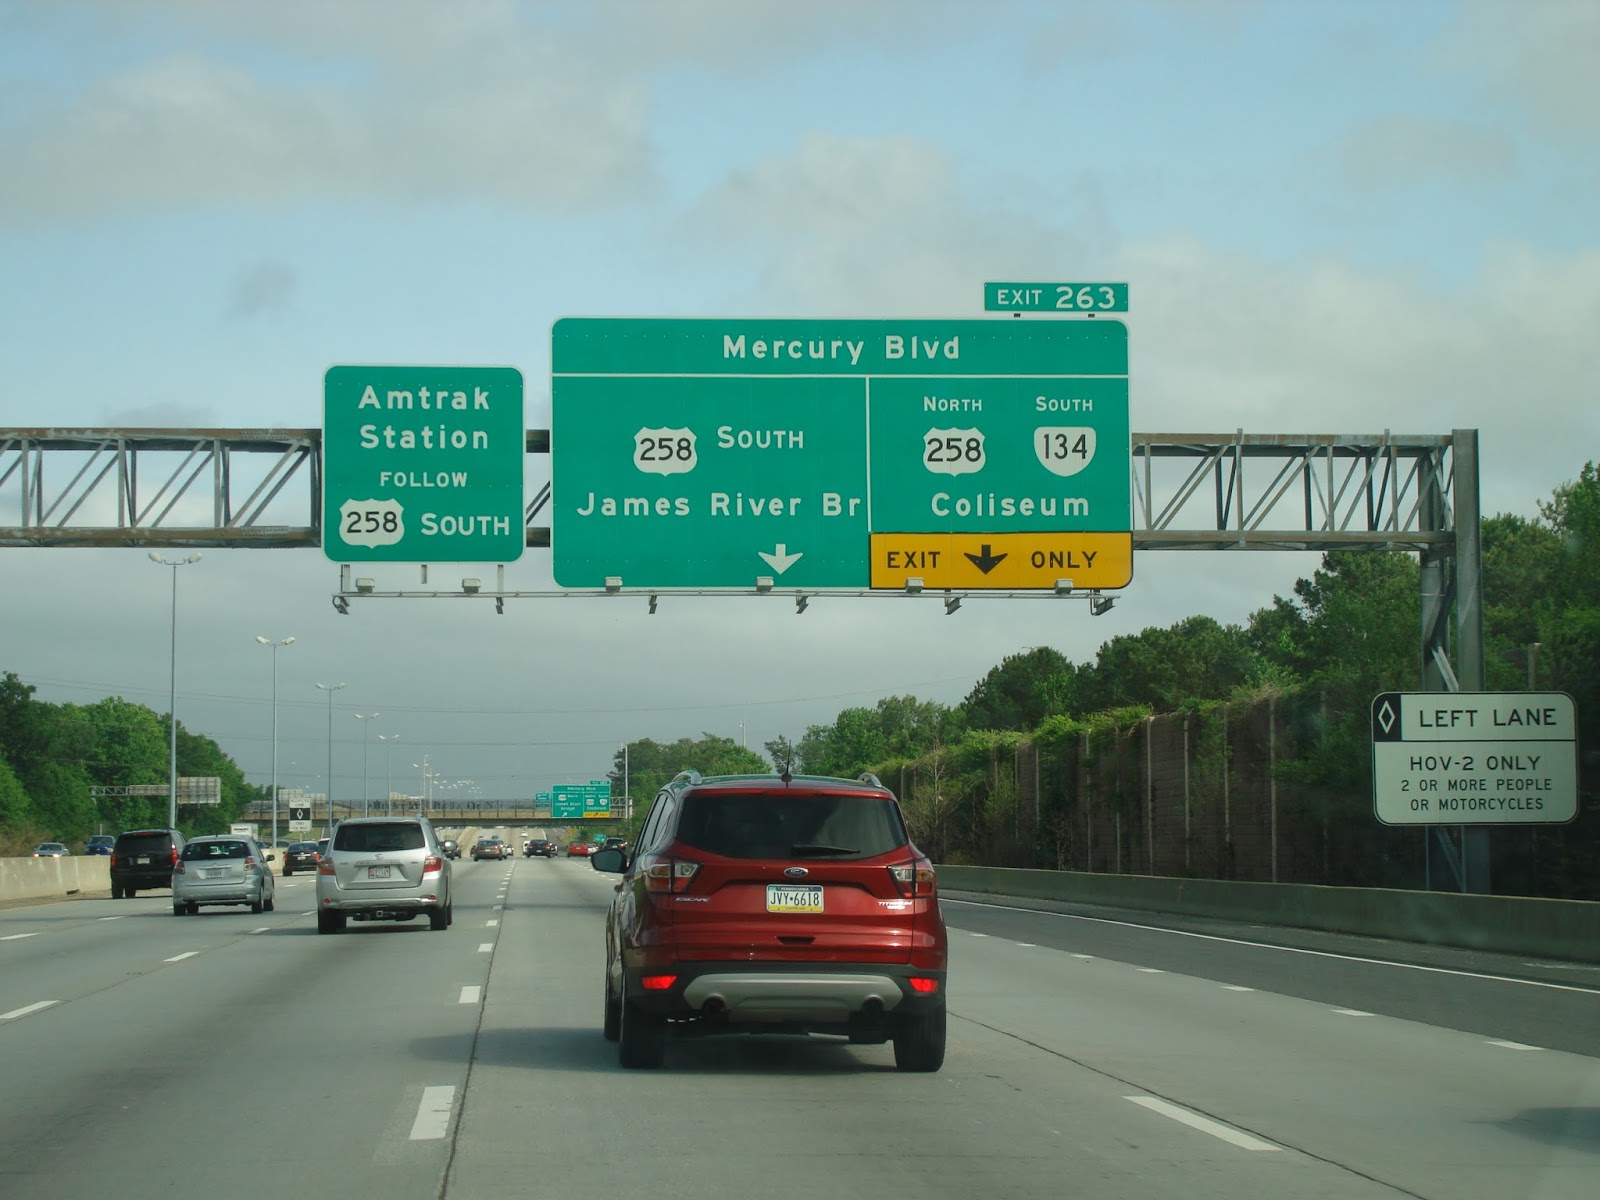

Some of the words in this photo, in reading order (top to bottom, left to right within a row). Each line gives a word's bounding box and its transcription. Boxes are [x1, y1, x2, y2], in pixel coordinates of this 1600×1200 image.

[997, 289, 1043, 305] EXIT
[1055, 286, 1116, 309] 263
[723, 334, 865, 366] Mercury
[885, 335, 960, 359] Blvd
[357, 385, 490, 410] Amtrak
[923, 396, 983, 412] NORTH
[1035, 396, 1093, 412] SOUTH
[359, 424, 489, 449] Station
[639, 437, 692, 461] 258
[716, 425, 804, 449] SOUTH
[1043, 433, 1088, 460] 134
[927, 437, 982, 463] 258
[379, 472, 468, 488] FOLLOW
[576, 492, 690, 517] James
[710, 492, 802, 517] River
[822, 492, 861, 517] Br
[931, 492, 1089, 517] Coliseum
[346, 510, 398, 534] 258
[420, 512, 510, 536] SOUTH
[887, 551, 941, 569] EXIT
[1031, 551, 1098, 569] ONLY
[1419, 709, 1478, 728] LEFT
[1493, 708, 1557, 726] LANE
[1410, 755, 1474, 771] HOV-2
[1486, 755, 1541, 770] ONLY
[1401, 779, 1410, 791] 2
[1419, 779, 1438, 791] OR
[1448, 779, 1487, 791] MORE
[1496, 778, 1553, 791] PEOPLE
[1410, 799, 1429, 811] OR
[1438, 797, 1544, 811] MOTORCYCLES
